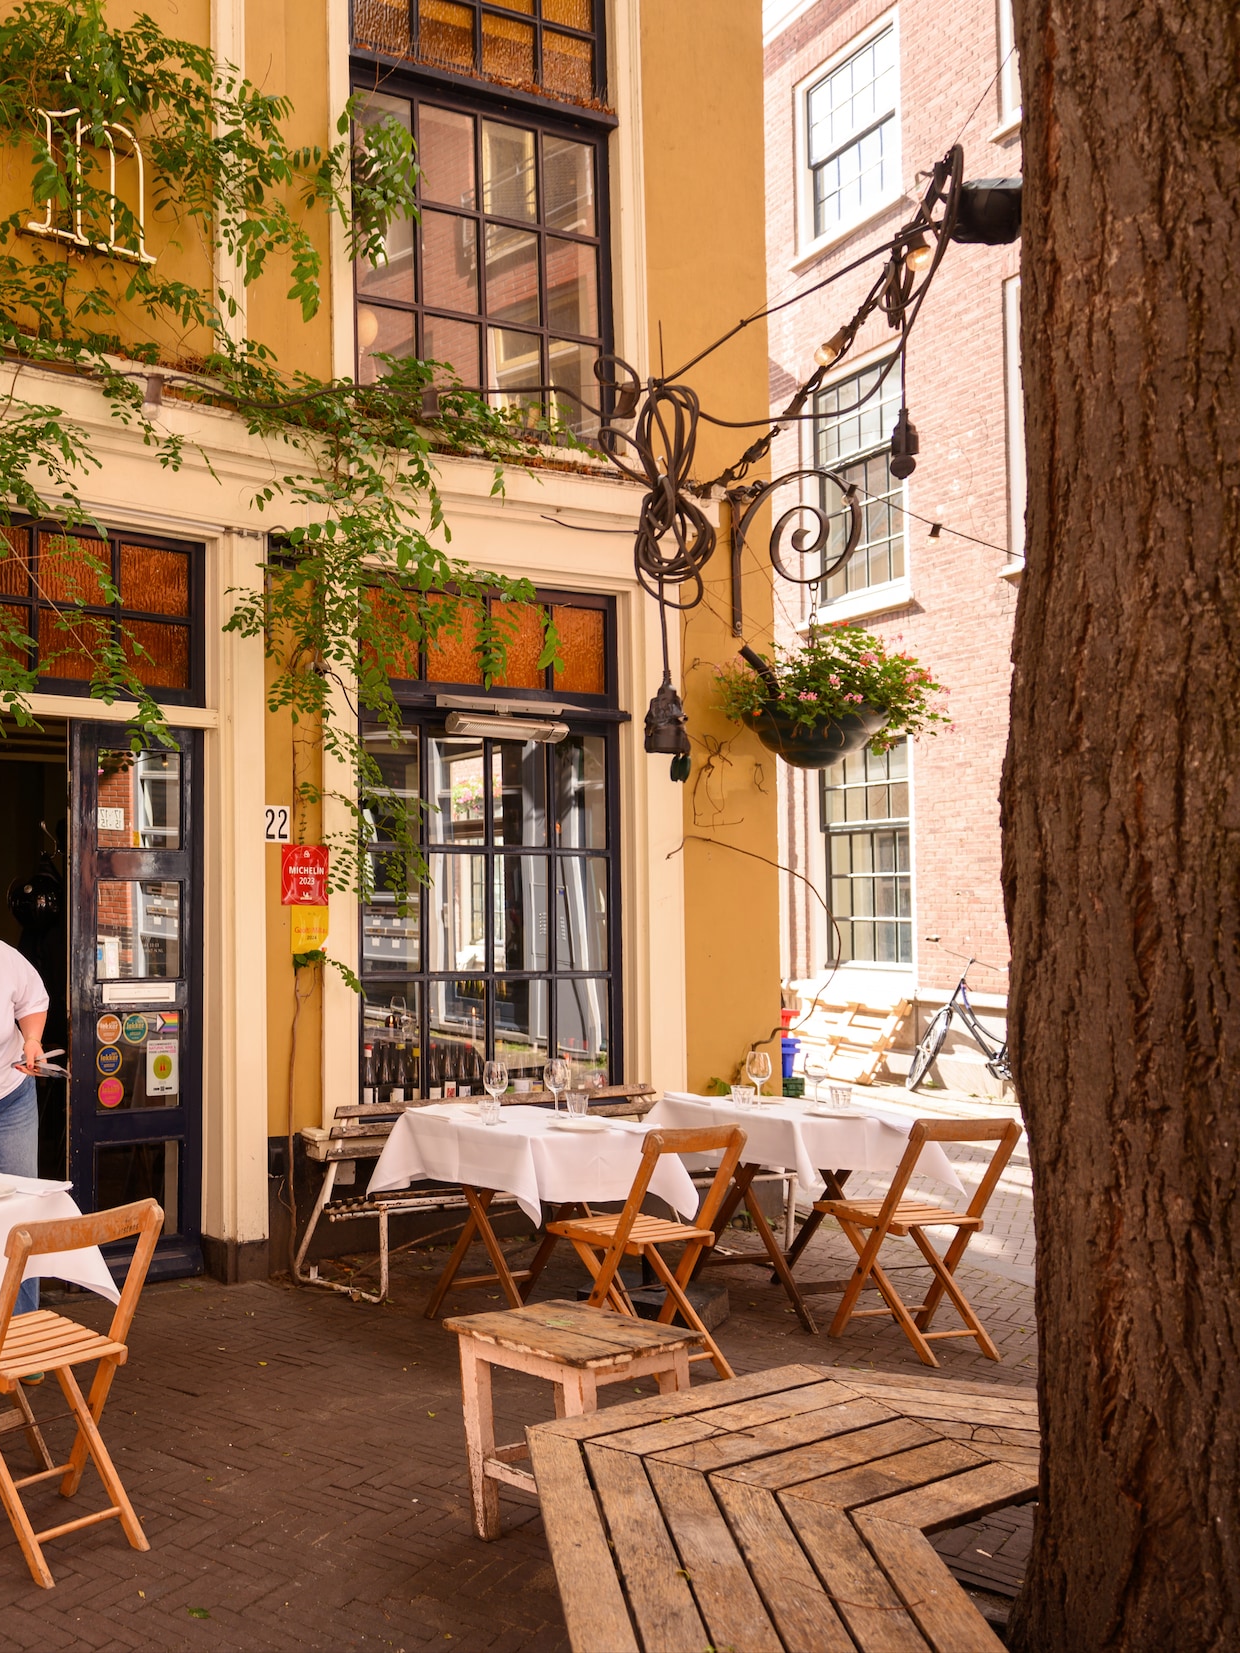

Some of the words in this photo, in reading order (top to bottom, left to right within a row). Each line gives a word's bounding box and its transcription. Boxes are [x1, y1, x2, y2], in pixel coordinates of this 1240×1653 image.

[265, 809, 288, 839] 22
[288, 866, 325, 875] MICHELIN
[299, 877, 315, 885] 2023
